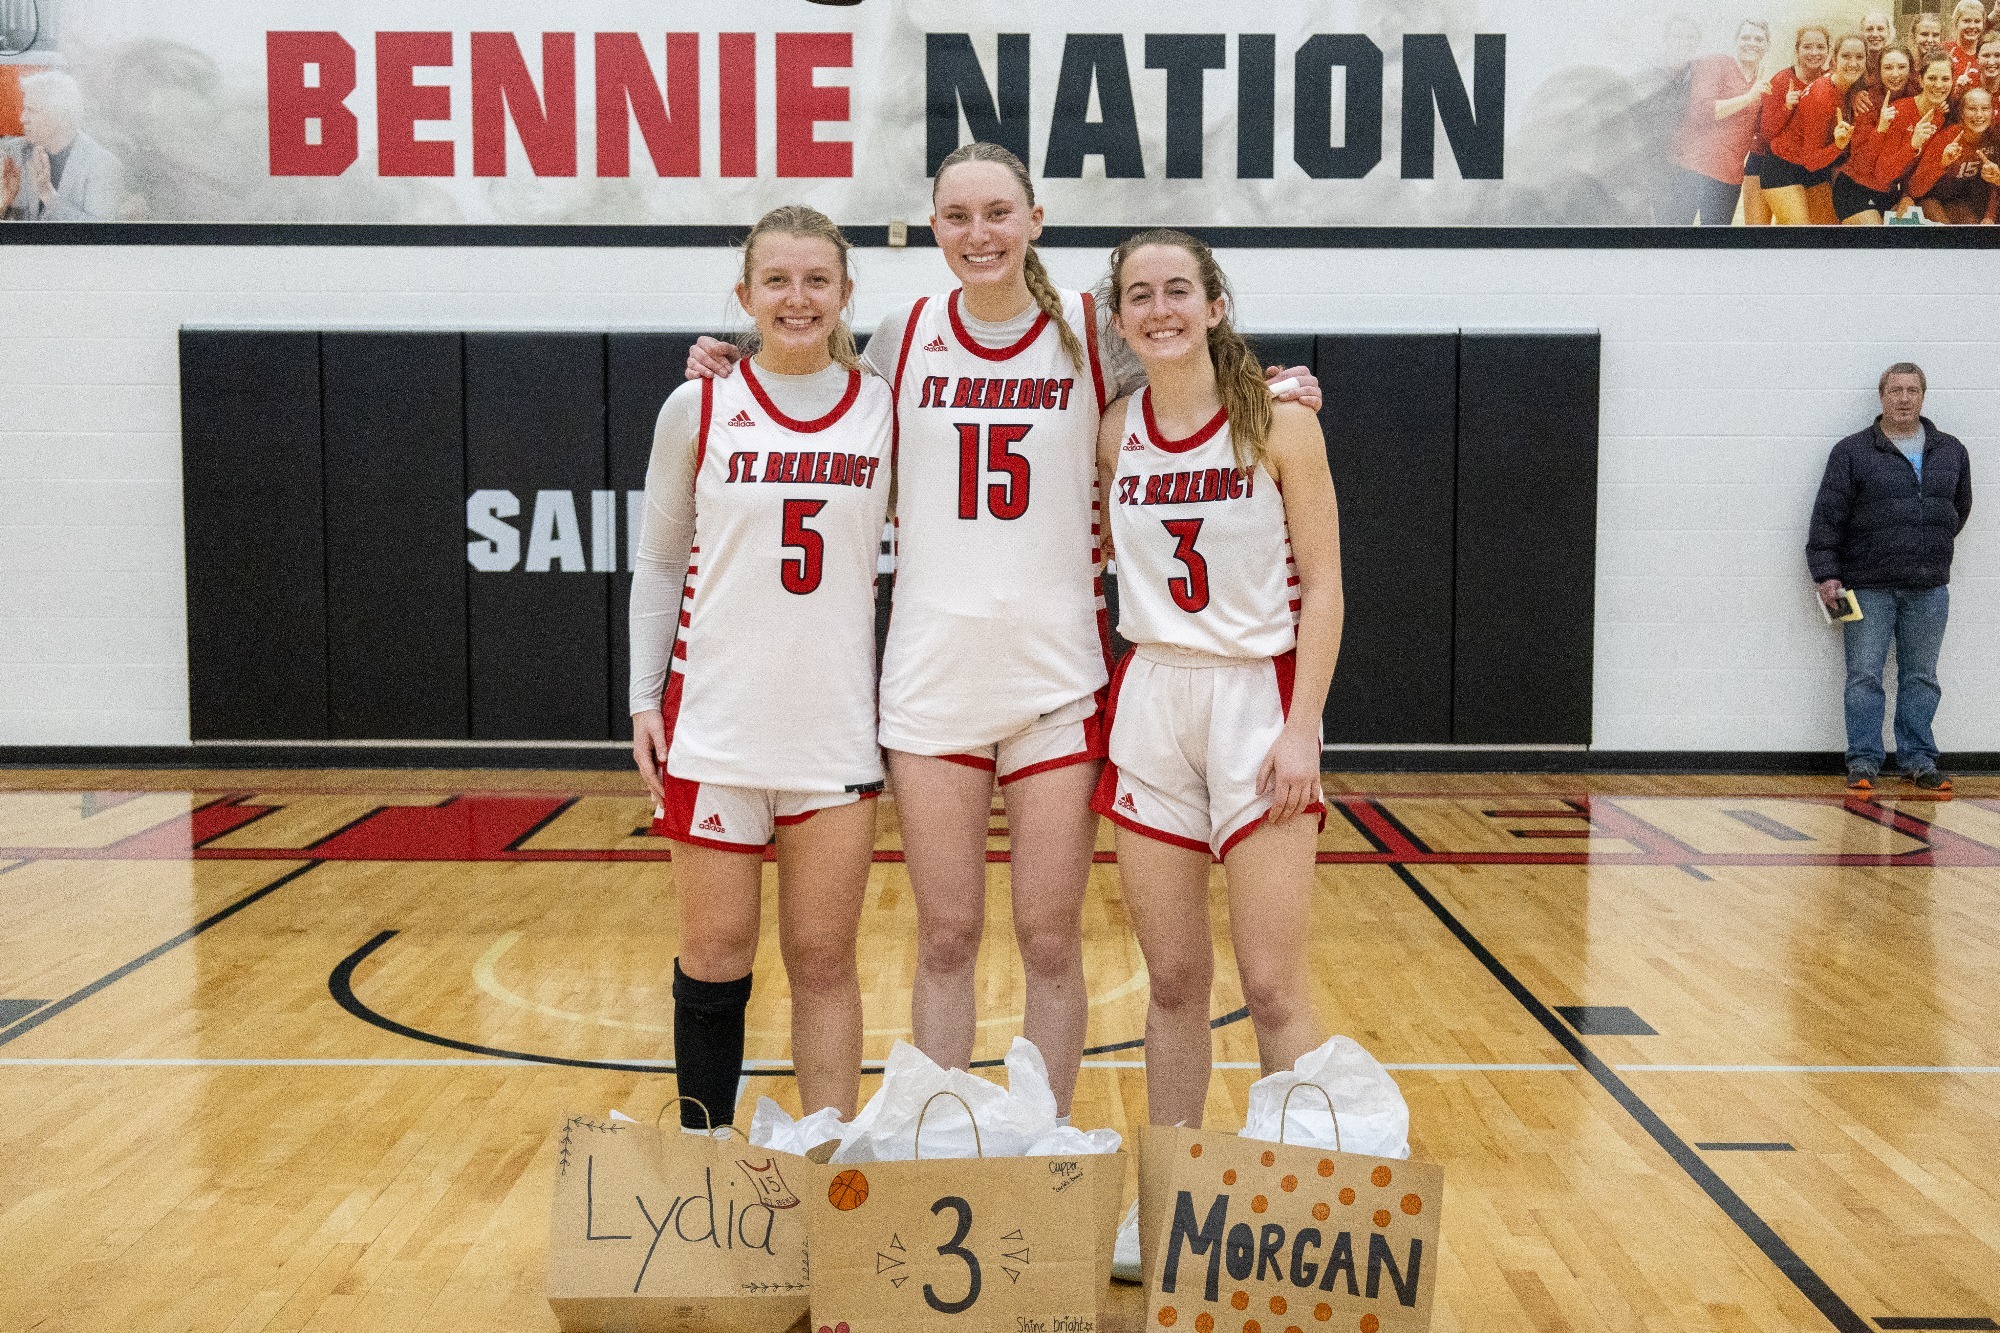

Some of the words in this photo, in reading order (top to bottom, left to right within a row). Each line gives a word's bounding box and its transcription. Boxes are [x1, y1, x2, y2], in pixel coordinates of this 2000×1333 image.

[267, 31, 853, 177] BENNIE
[926, 33, 1506, 179] NATION
[1956, 161, 1980, 178] 15
[918, 376, 949, 408] ST.
[950, 377, 1074, 410] BENEDICT
[725, 452, 758, 483] ST.
[761, 452, 880, 489] BENEDICT
[953, 423, 1033, 520] 15
[1141, 465, 1255, 505] BENEDICT
[781, 499, 828, 595] 5
[1161, 518, 1210, 613] 3
[699, 822, 726, 833] adidas
[758, 1176, 780, 1195] 15
[587, 1155, 775, 1293] Lydia
[923, 1195, 982, 1314] 3
[1162, 1190, 1423, 1308] MORGAN
[1016, 1316, 1046, 1333] Shine
[1053, 1315, 1084, 1333] bright
